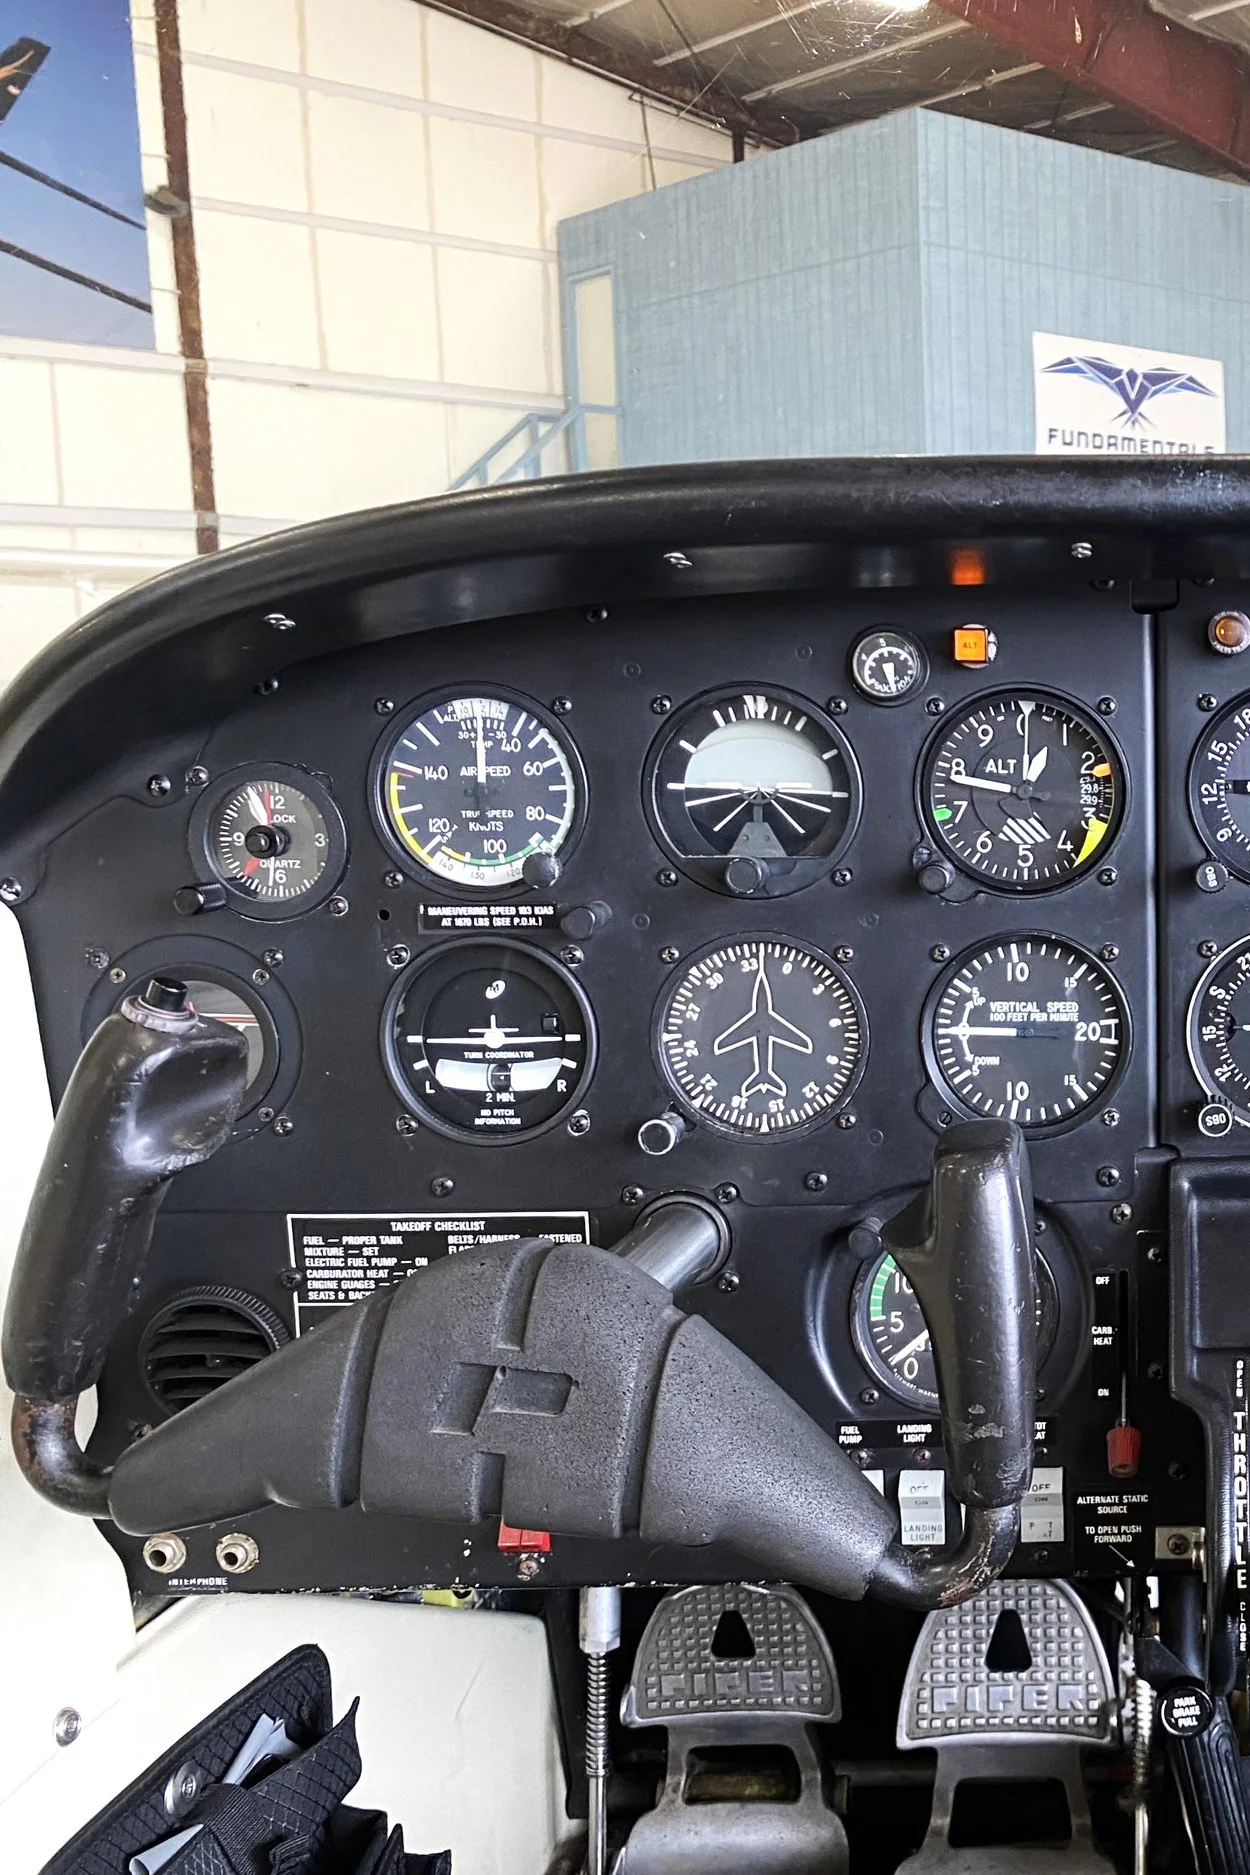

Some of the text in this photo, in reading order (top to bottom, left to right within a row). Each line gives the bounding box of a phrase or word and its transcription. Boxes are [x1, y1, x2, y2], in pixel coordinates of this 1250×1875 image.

[460, 766, 511, 776] AIRPEED
[523, 761, 543, 775] 60
[985, 759, 1017, 774] ALT
[484, 839, 507, 853] 100
[1017, 845, 1034, 867] 5
[427, 906, 488, 916] MANEUVERING
[489, 906, 516, 915] SPEED
[534, 906, 554, 915] KIAS
[441, 918, 453, 927] AT
[473, 917, 490, 926] LBS
[492, 917, 511, 926] (SEE
[1007, 962, 1029, 981] 10
[990, 1002, 1079, 1012] VERTICAL SPEED
[990, 1012, 1079, 1021] 100 FEET PER MINUTE
[1075, 1022, 1101, 1041] 20
[485, 1051, 534, 1059] COORDINATOR
[975, 1056, 1000, 1066] DOWN
[391, 1221, 486, 1231] TAKEOFF CHECKLIST
[303, 1236, 403, 1245] FUEL PROPER TANK
[304, 1247, 379, 1256] MIXTURE SET
[305, 1258, 428, 1267] ELECTRIC FUEL PUMP ON
[306, 1269, 389, 1278] CARBURATOR HEAT
[307, 1280, 375, 1289] ENGINE GUAGES
[1095, 1277, 1110, 1285] OFF
[308, 1291, 335, 1300] SEATS
[1093, 1336, 1113, 1345] HEAT
[1236, 1360, 1244, 1398] OPEN
[1097, 1388, 1109, 1397] ON
[841, 1426, 860, 1434] FUEL
[897, 1424, 932, 1433] LANDING
[839, 1435, 862, 1444] PUMP
[903, 1434, 926, 1443] LIGHT
[1077, 1495, 1149, 1504] ALTERNATE STATIC
[1233, 1411, 1247, 1590] THROTTLE
[1097, 1506, 1128, 1514] SOURCE
[1085, 1525, 1142, 1534] TO OPEN PUSH
[910, 1534, 935, 1542] LIGHT
[1094, 1535, 1132, 1543] FORWARD
[1239, 1601, 1247, 1652] CLOSE
[932, 1684, 1087, 1712] PIPER
[1174, 1696, 1197, 1707] PARK
[1172, 1705, 1201, 1718] BRAKE
[1178, 1717, 1198, 1728] PULL
